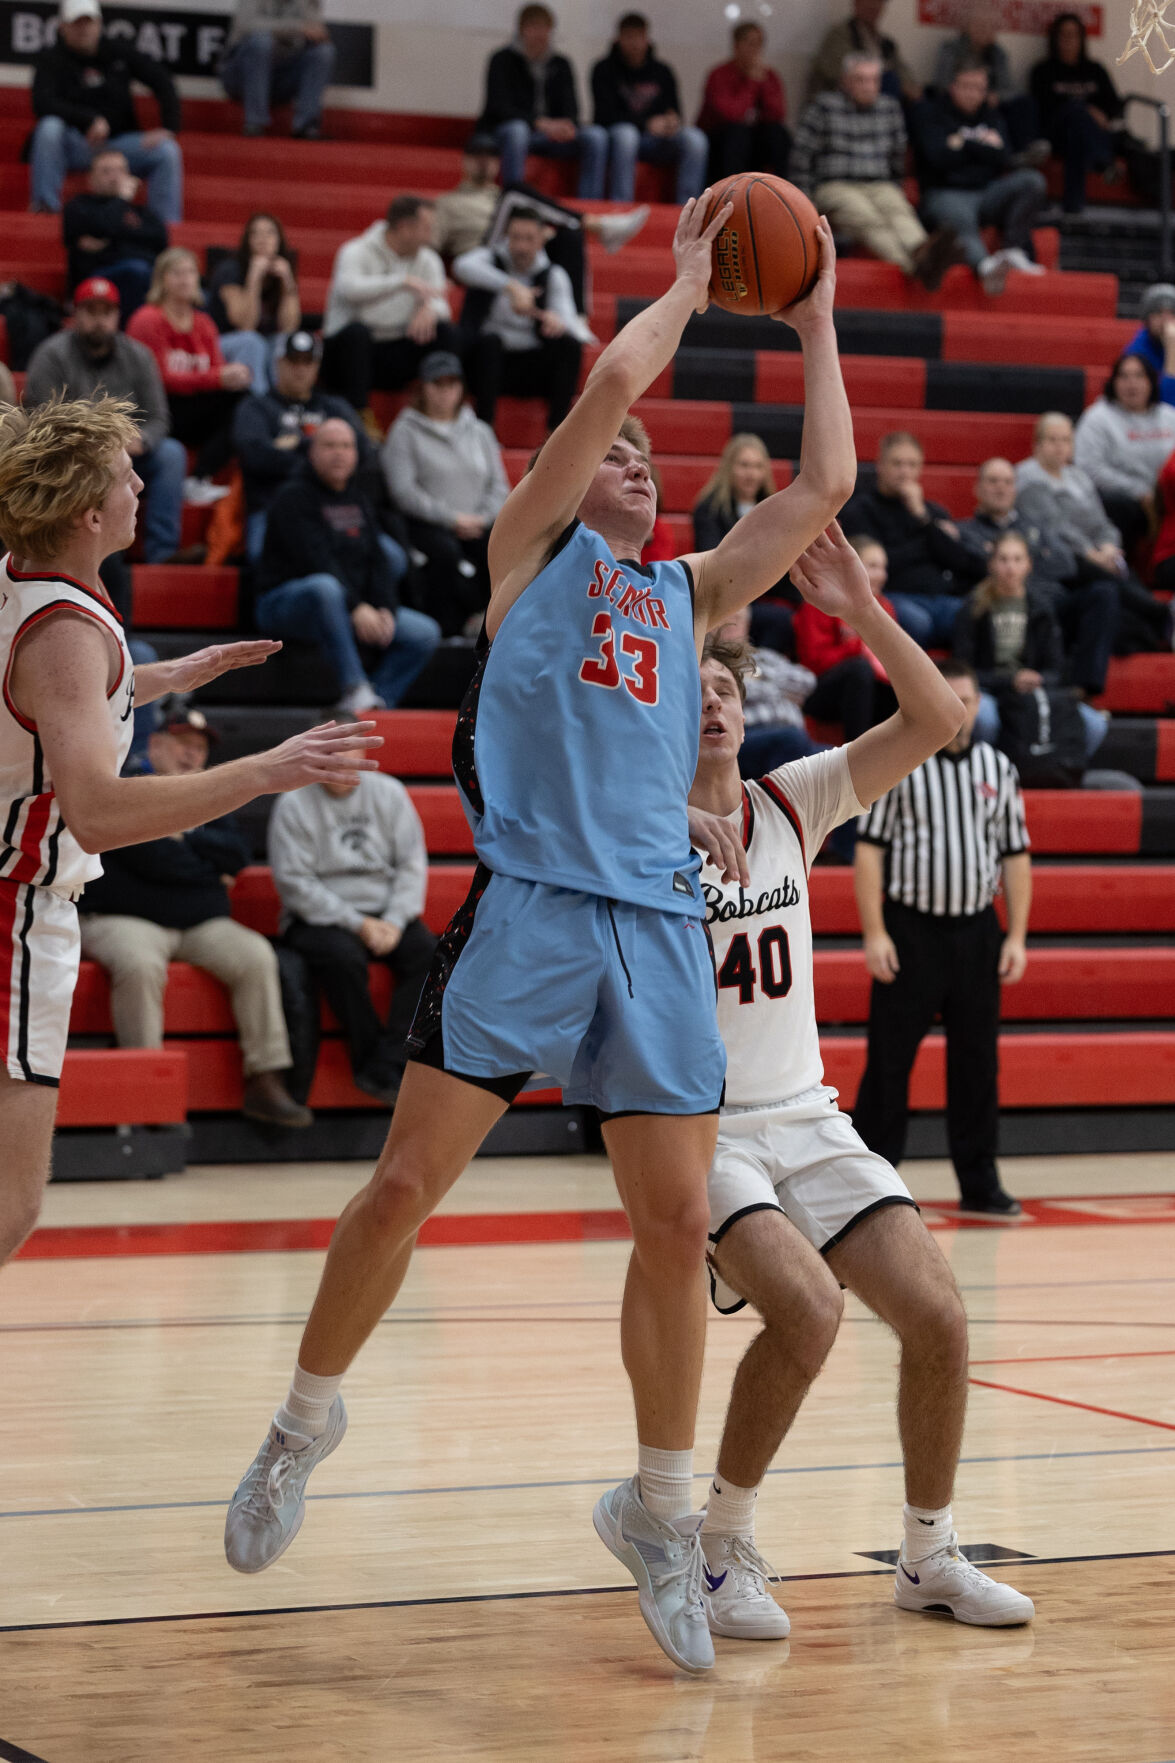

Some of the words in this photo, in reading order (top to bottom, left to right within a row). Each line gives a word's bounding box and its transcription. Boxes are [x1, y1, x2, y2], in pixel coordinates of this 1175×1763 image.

[11, 11, 188, 63] BCAT
[587, 559, 672, 632] SENOR
[578, 610, 660, 707] 33
[701, 875, 800, 925] Bobcats
[718, 924, 793, 1005] 40
